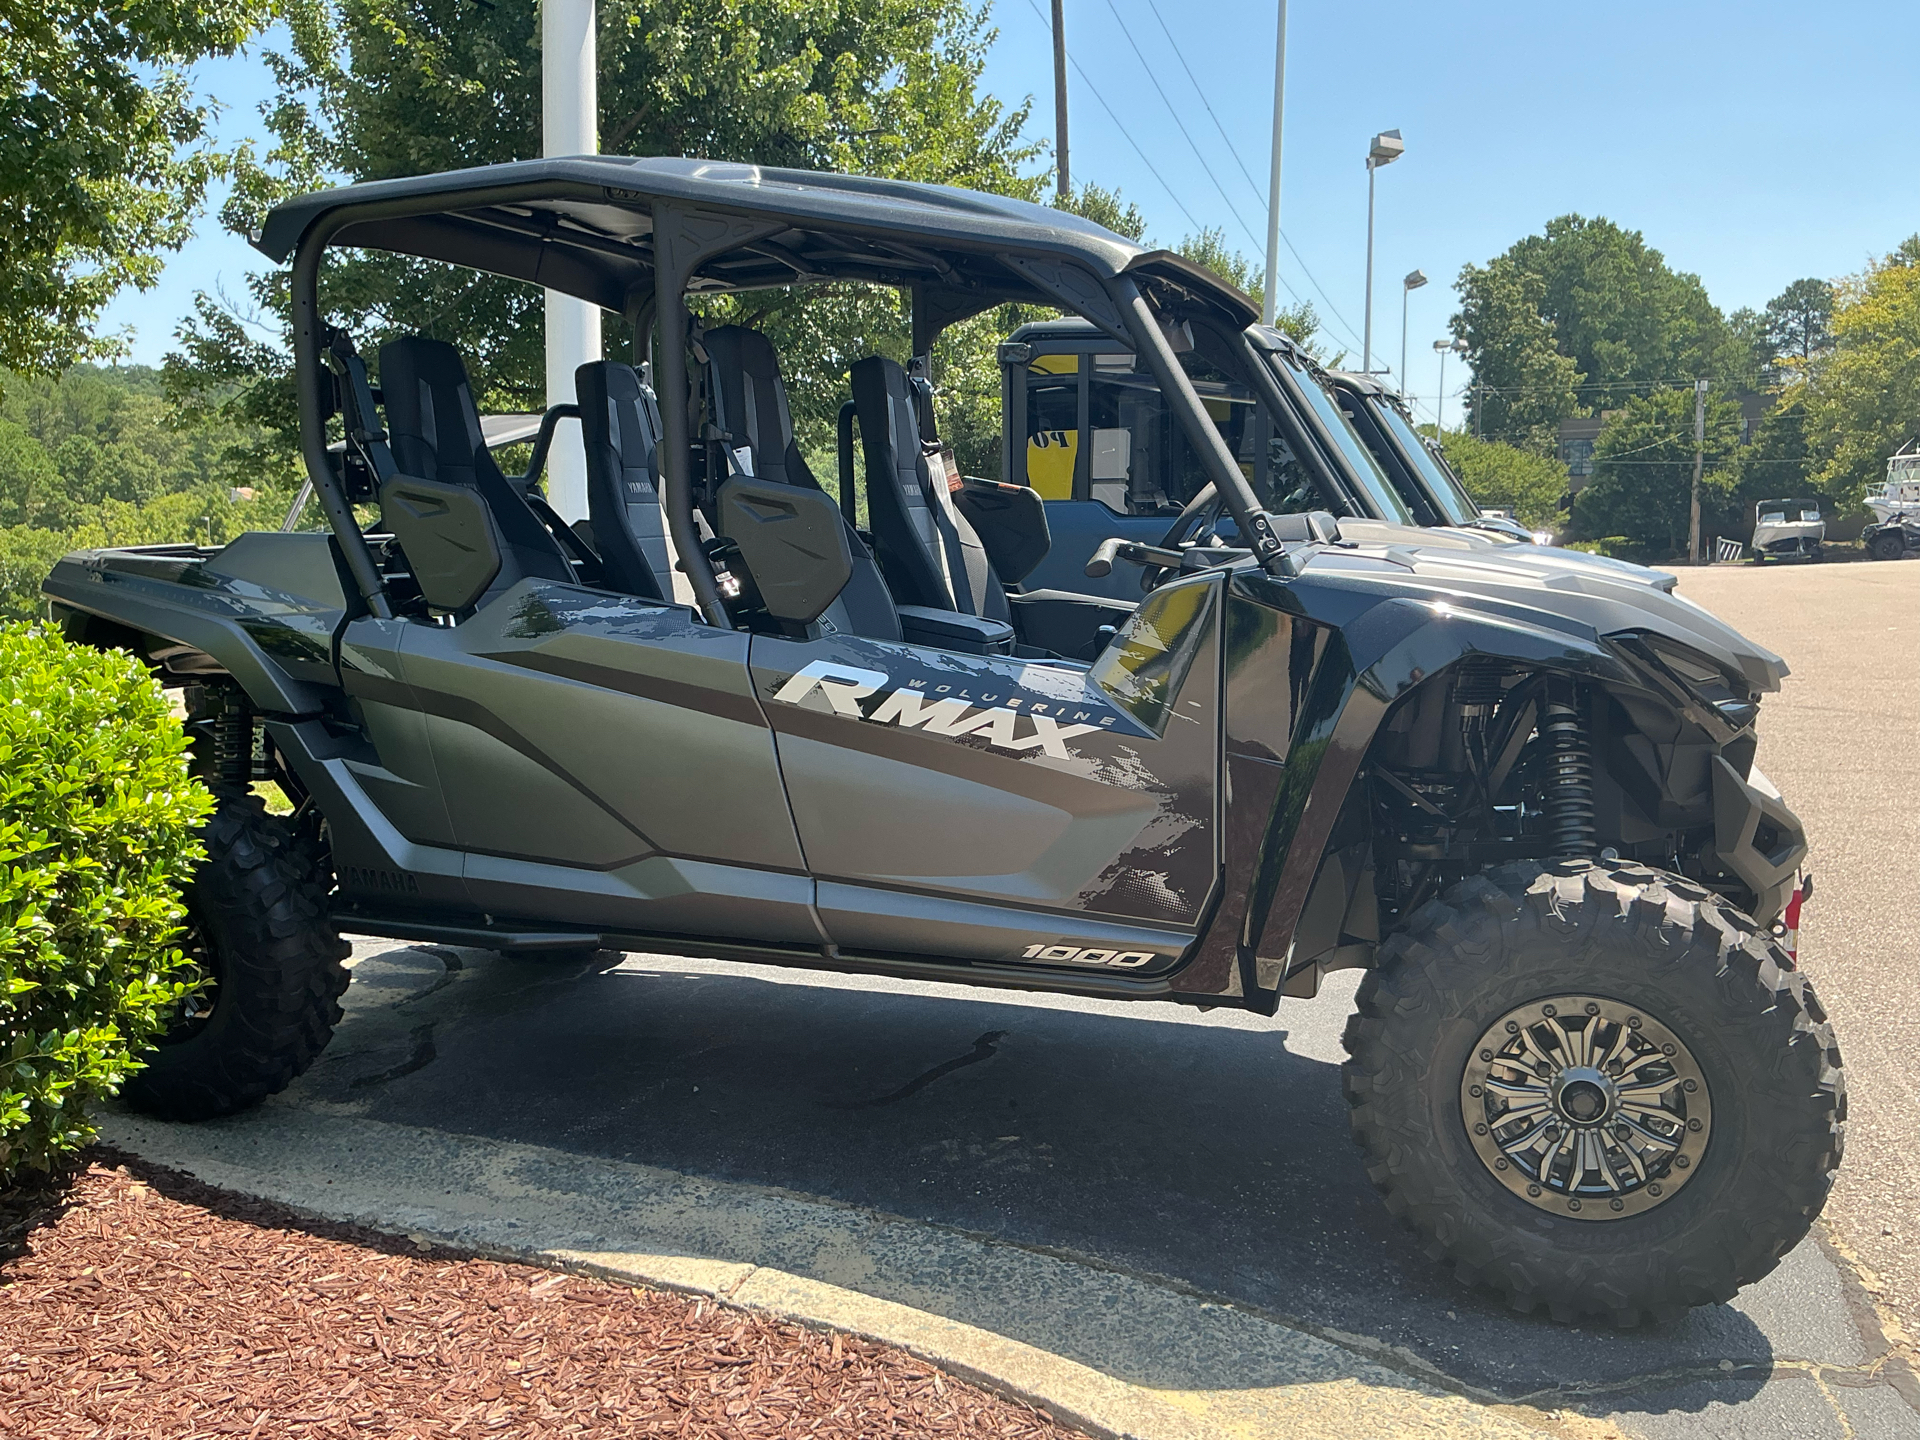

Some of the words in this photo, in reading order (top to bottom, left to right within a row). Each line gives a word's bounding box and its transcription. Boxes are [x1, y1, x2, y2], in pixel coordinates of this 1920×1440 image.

[773, 659, 1104, 761] RMAX
[908, 678, 1117, 726] WOLVERINE
[251, 727, 265, 759] FOX
[335, 864, 423, 894] YAMAHA
[1022, 943, 1156, 968] 1000
